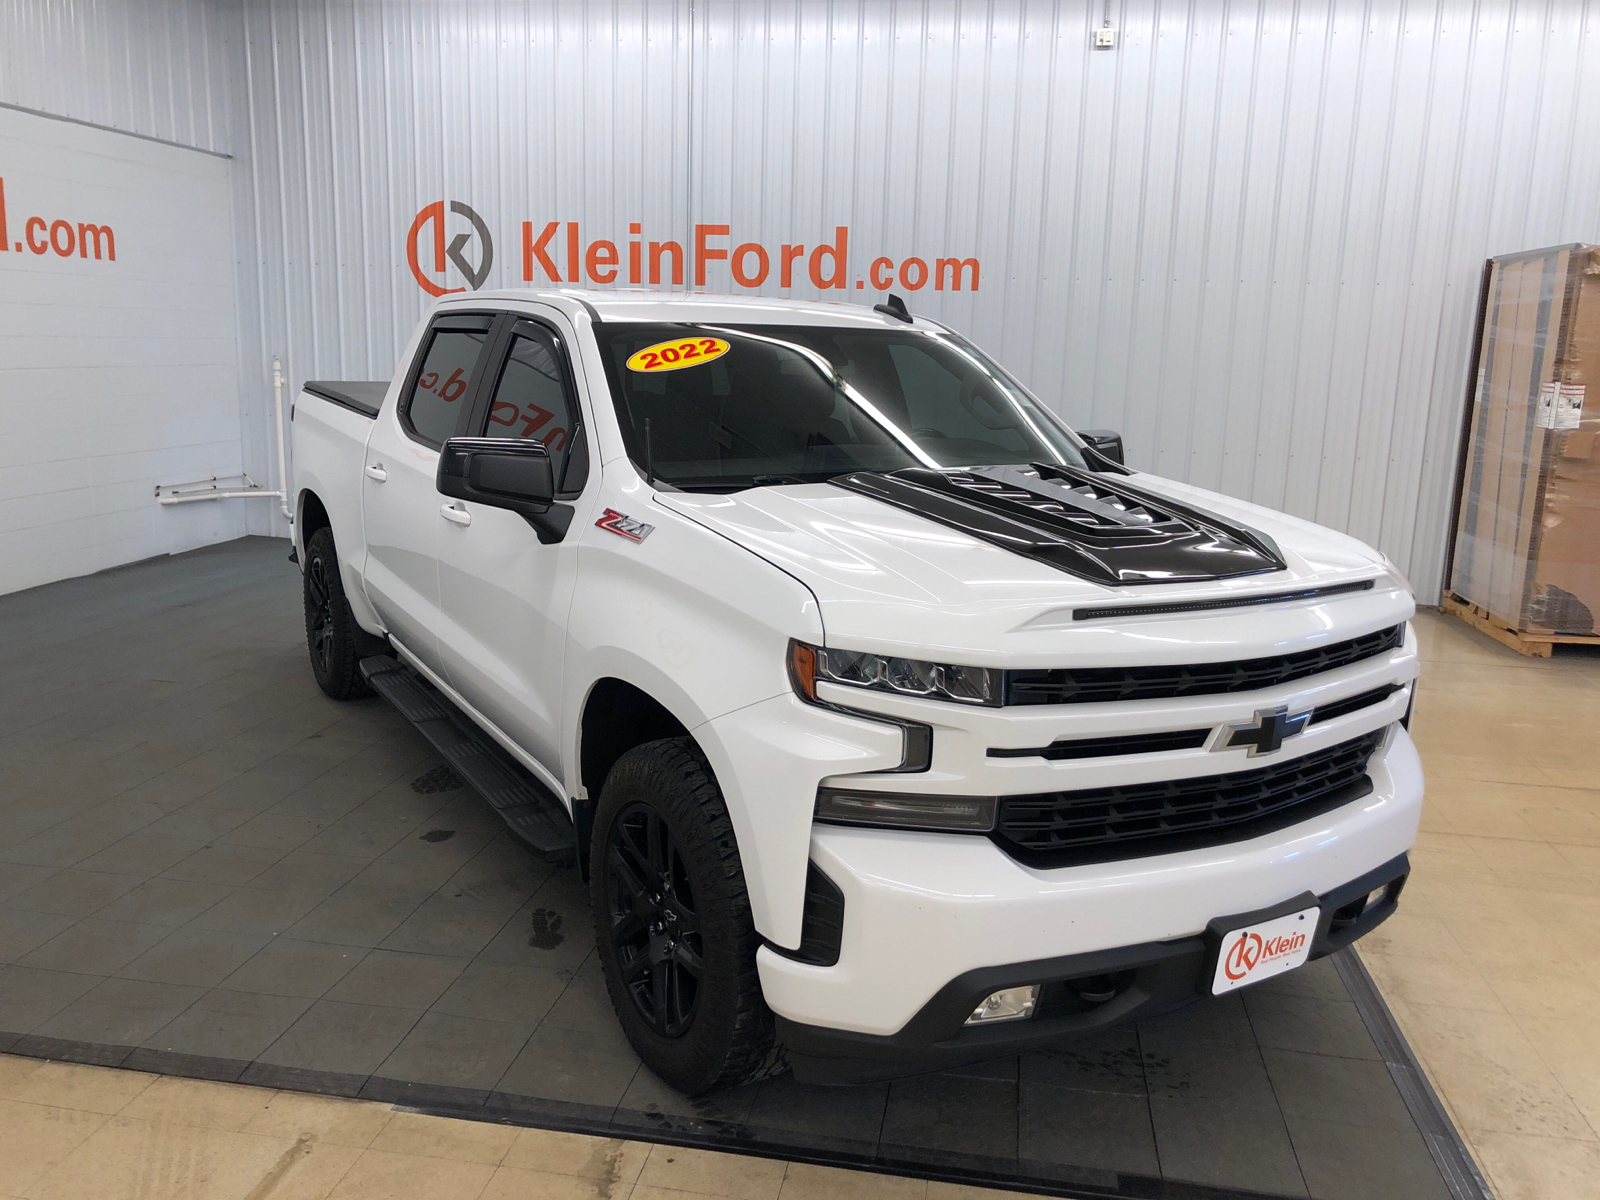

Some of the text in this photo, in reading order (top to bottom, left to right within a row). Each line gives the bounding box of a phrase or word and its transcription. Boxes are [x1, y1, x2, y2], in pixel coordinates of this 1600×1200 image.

[521, 220, 980, 292] KleinFord.com
[640, 339, 722, 370] 2022
[594, 507, 656, 545] Z71
[1262, 931, 1306, 959] Klein
